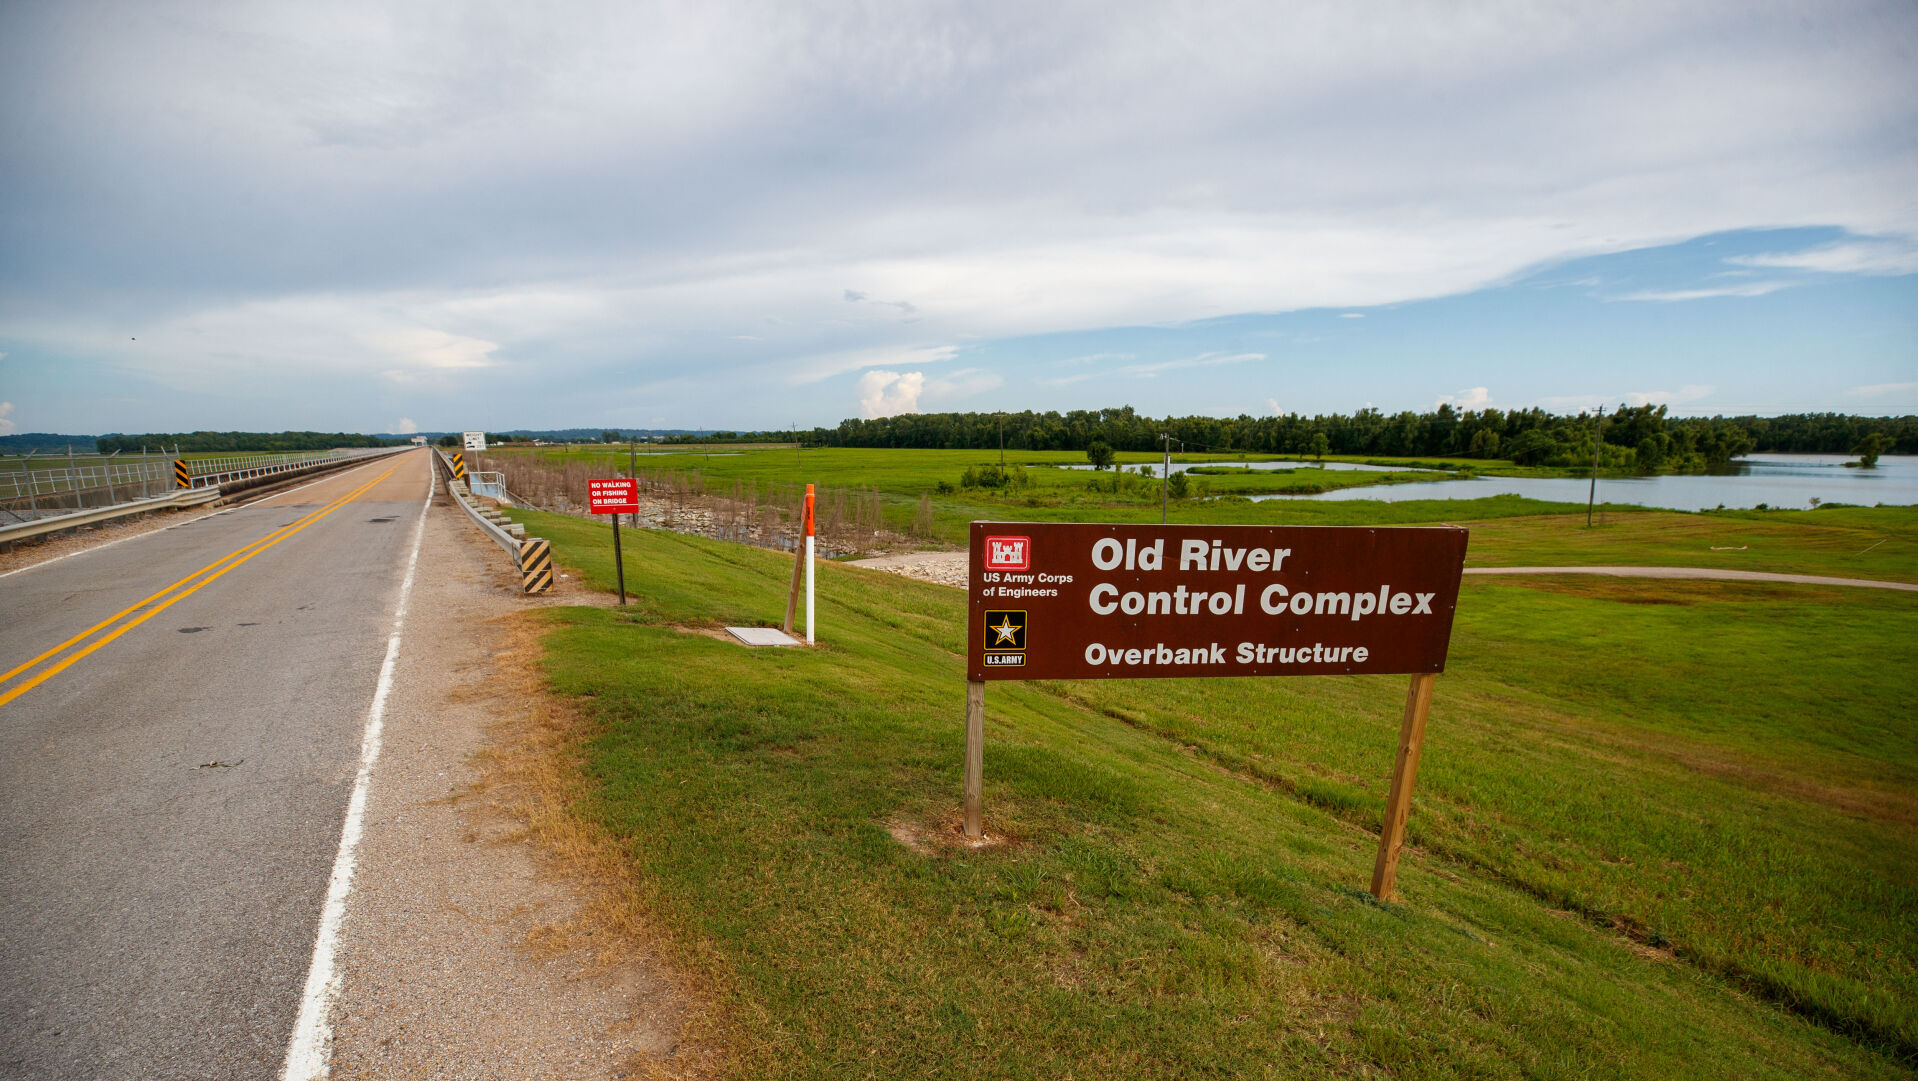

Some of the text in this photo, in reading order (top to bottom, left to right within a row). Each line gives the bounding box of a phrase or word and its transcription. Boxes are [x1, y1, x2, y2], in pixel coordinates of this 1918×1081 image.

[1091, 537, 1291, 572] Old River
[983, 572, 1073, 585] US Army Corps
[982, 586, 1058, 599] of Engineers
[1089, 582, 1435, 621] Control Complex
[1084, 642, 1369, 666] Overbank Structure
